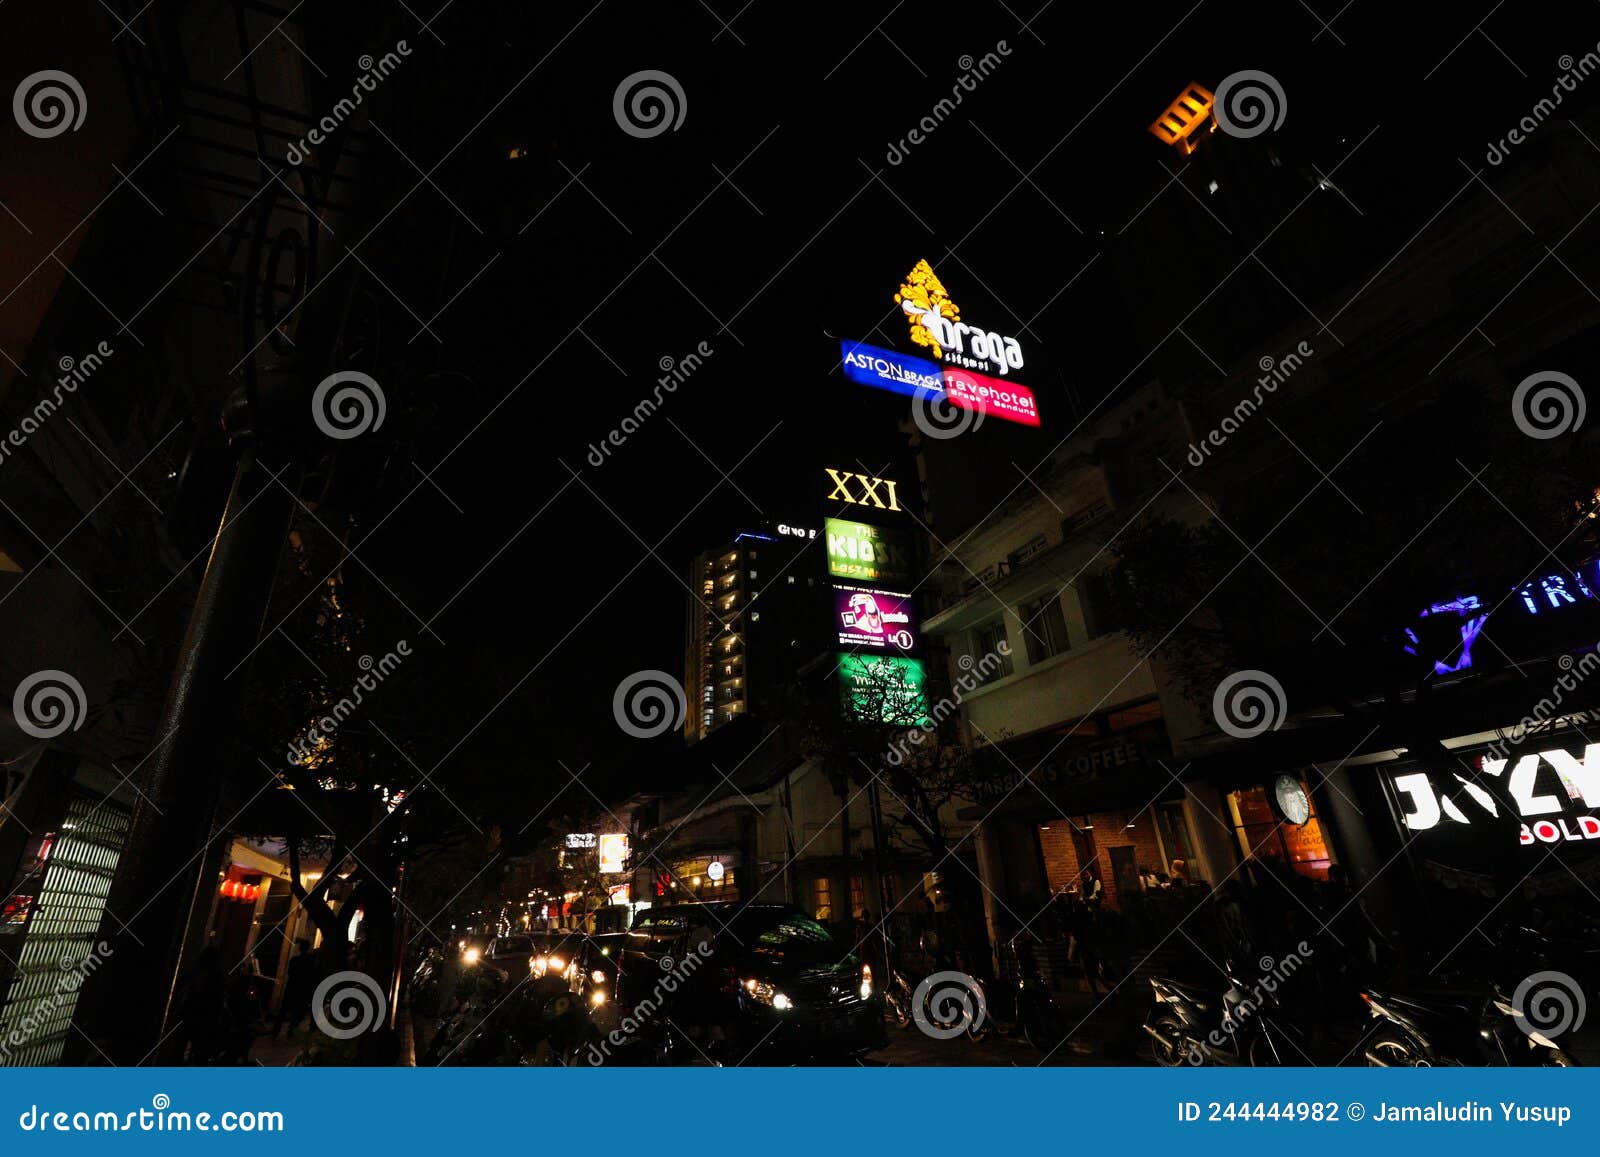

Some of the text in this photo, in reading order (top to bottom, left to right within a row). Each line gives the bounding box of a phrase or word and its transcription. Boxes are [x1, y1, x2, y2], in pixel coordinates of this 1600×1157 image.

[932, 306, 1024, 375] braga
[844, 352, 903, 377] ASTON
[904, 370, 942, 388] BRAGA
[947, 375, 1034, 409] favehotel
[825, 468, 902, 511] XXI
[854, 525, 880, 539] THE
[1520, 816, 1600, 845] BOLD
